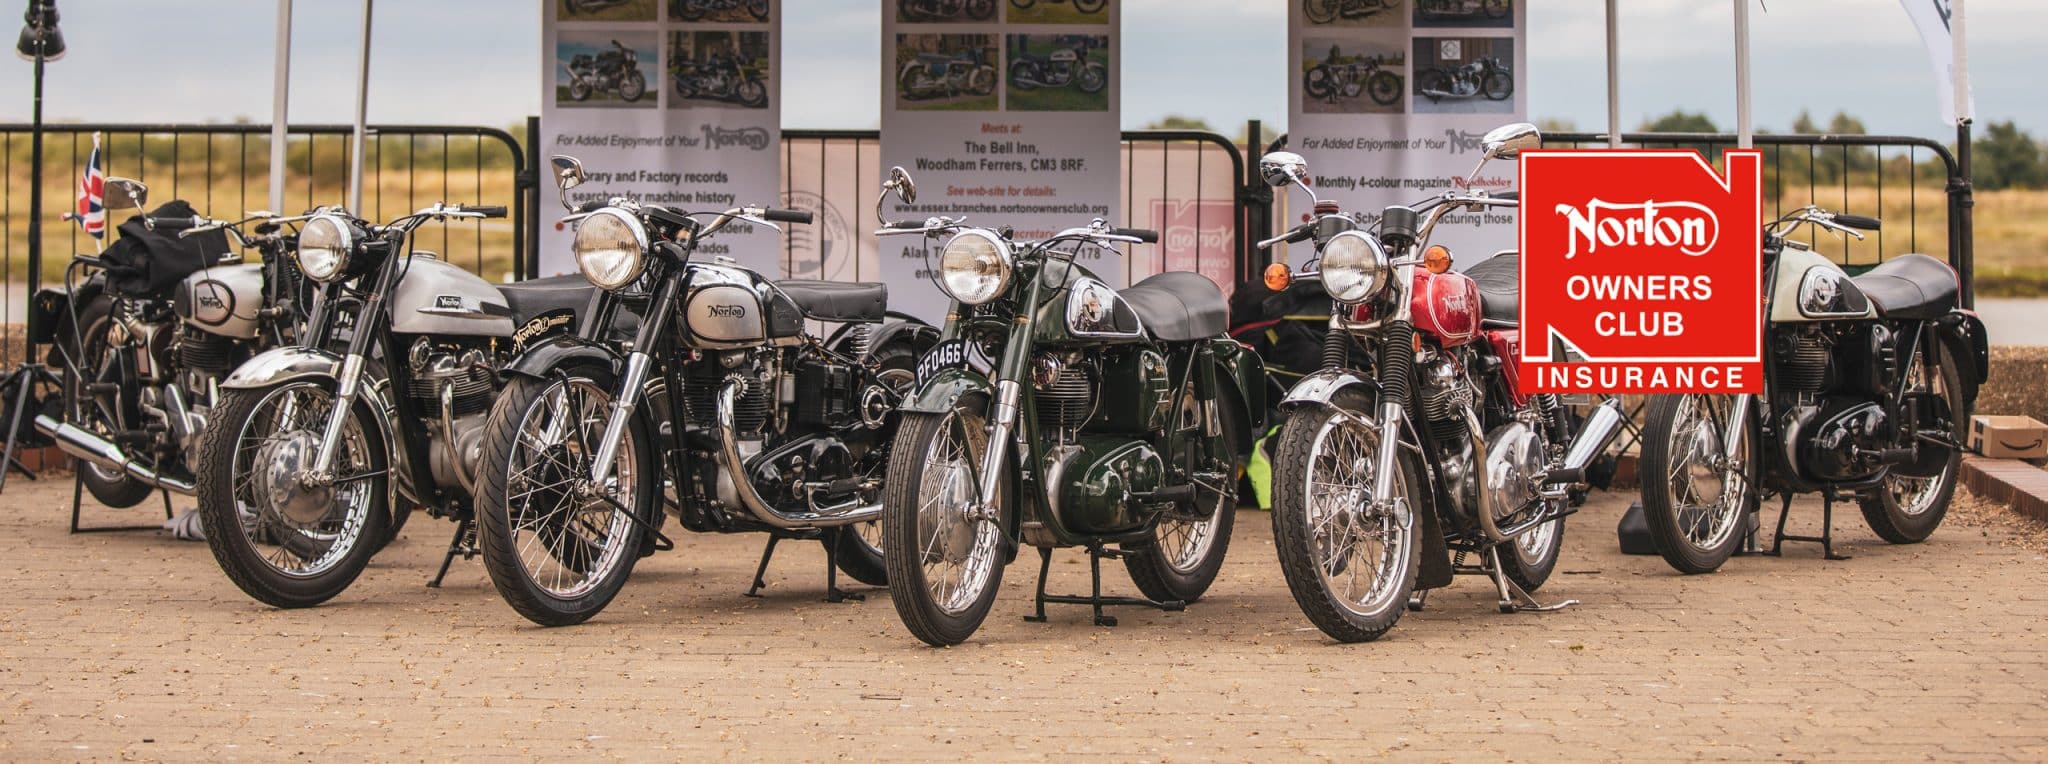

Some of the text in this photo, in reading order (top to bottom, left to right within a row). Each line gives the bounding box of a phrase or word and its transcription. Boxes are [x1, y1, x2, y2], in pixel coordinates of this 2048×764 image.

[981, 123, 1009, 134] Meets
[556, 124, 770, 150] For Added Enjoyment of Your Norton
[965, 141, 1040, 155] The Bell Inn,
[1303, 138, 1319, 149] For
[1321, 138, 1354, 150] Added
[1357, 138, 1409, 151] Enjoyment
[1411, 138, 1422, 149] of
[1423, 139, 1446, 150] Your
[916, 158, 976, 171] Woodham
[980, 158, 1027, 173] Ferrers,
[1031, 158, 1057, 171] CM3
[615, 171, 636, 182] and
[640, 170, 682, 185] Factory
[685, 171, 728, 183] records
[1316, 176, 1356, 190] Monthly
[1360, 176, 1401, 189] 4-colour
[1404, 177, 1451, 191] magazine
[645, 190, 692, 203] machine
[695, 190, 735, 206] history
[947, 186, 1057, 197] See web-site for details:
[895, 203, 1108, 216] www.essex.branches.nortonownersclub.org
[1484, 212, 1512, 224] those
[901, 246, 929, 258] Alan
[707, 304, 745, 319] Norton
[512, 319, 543, 354] Norton
